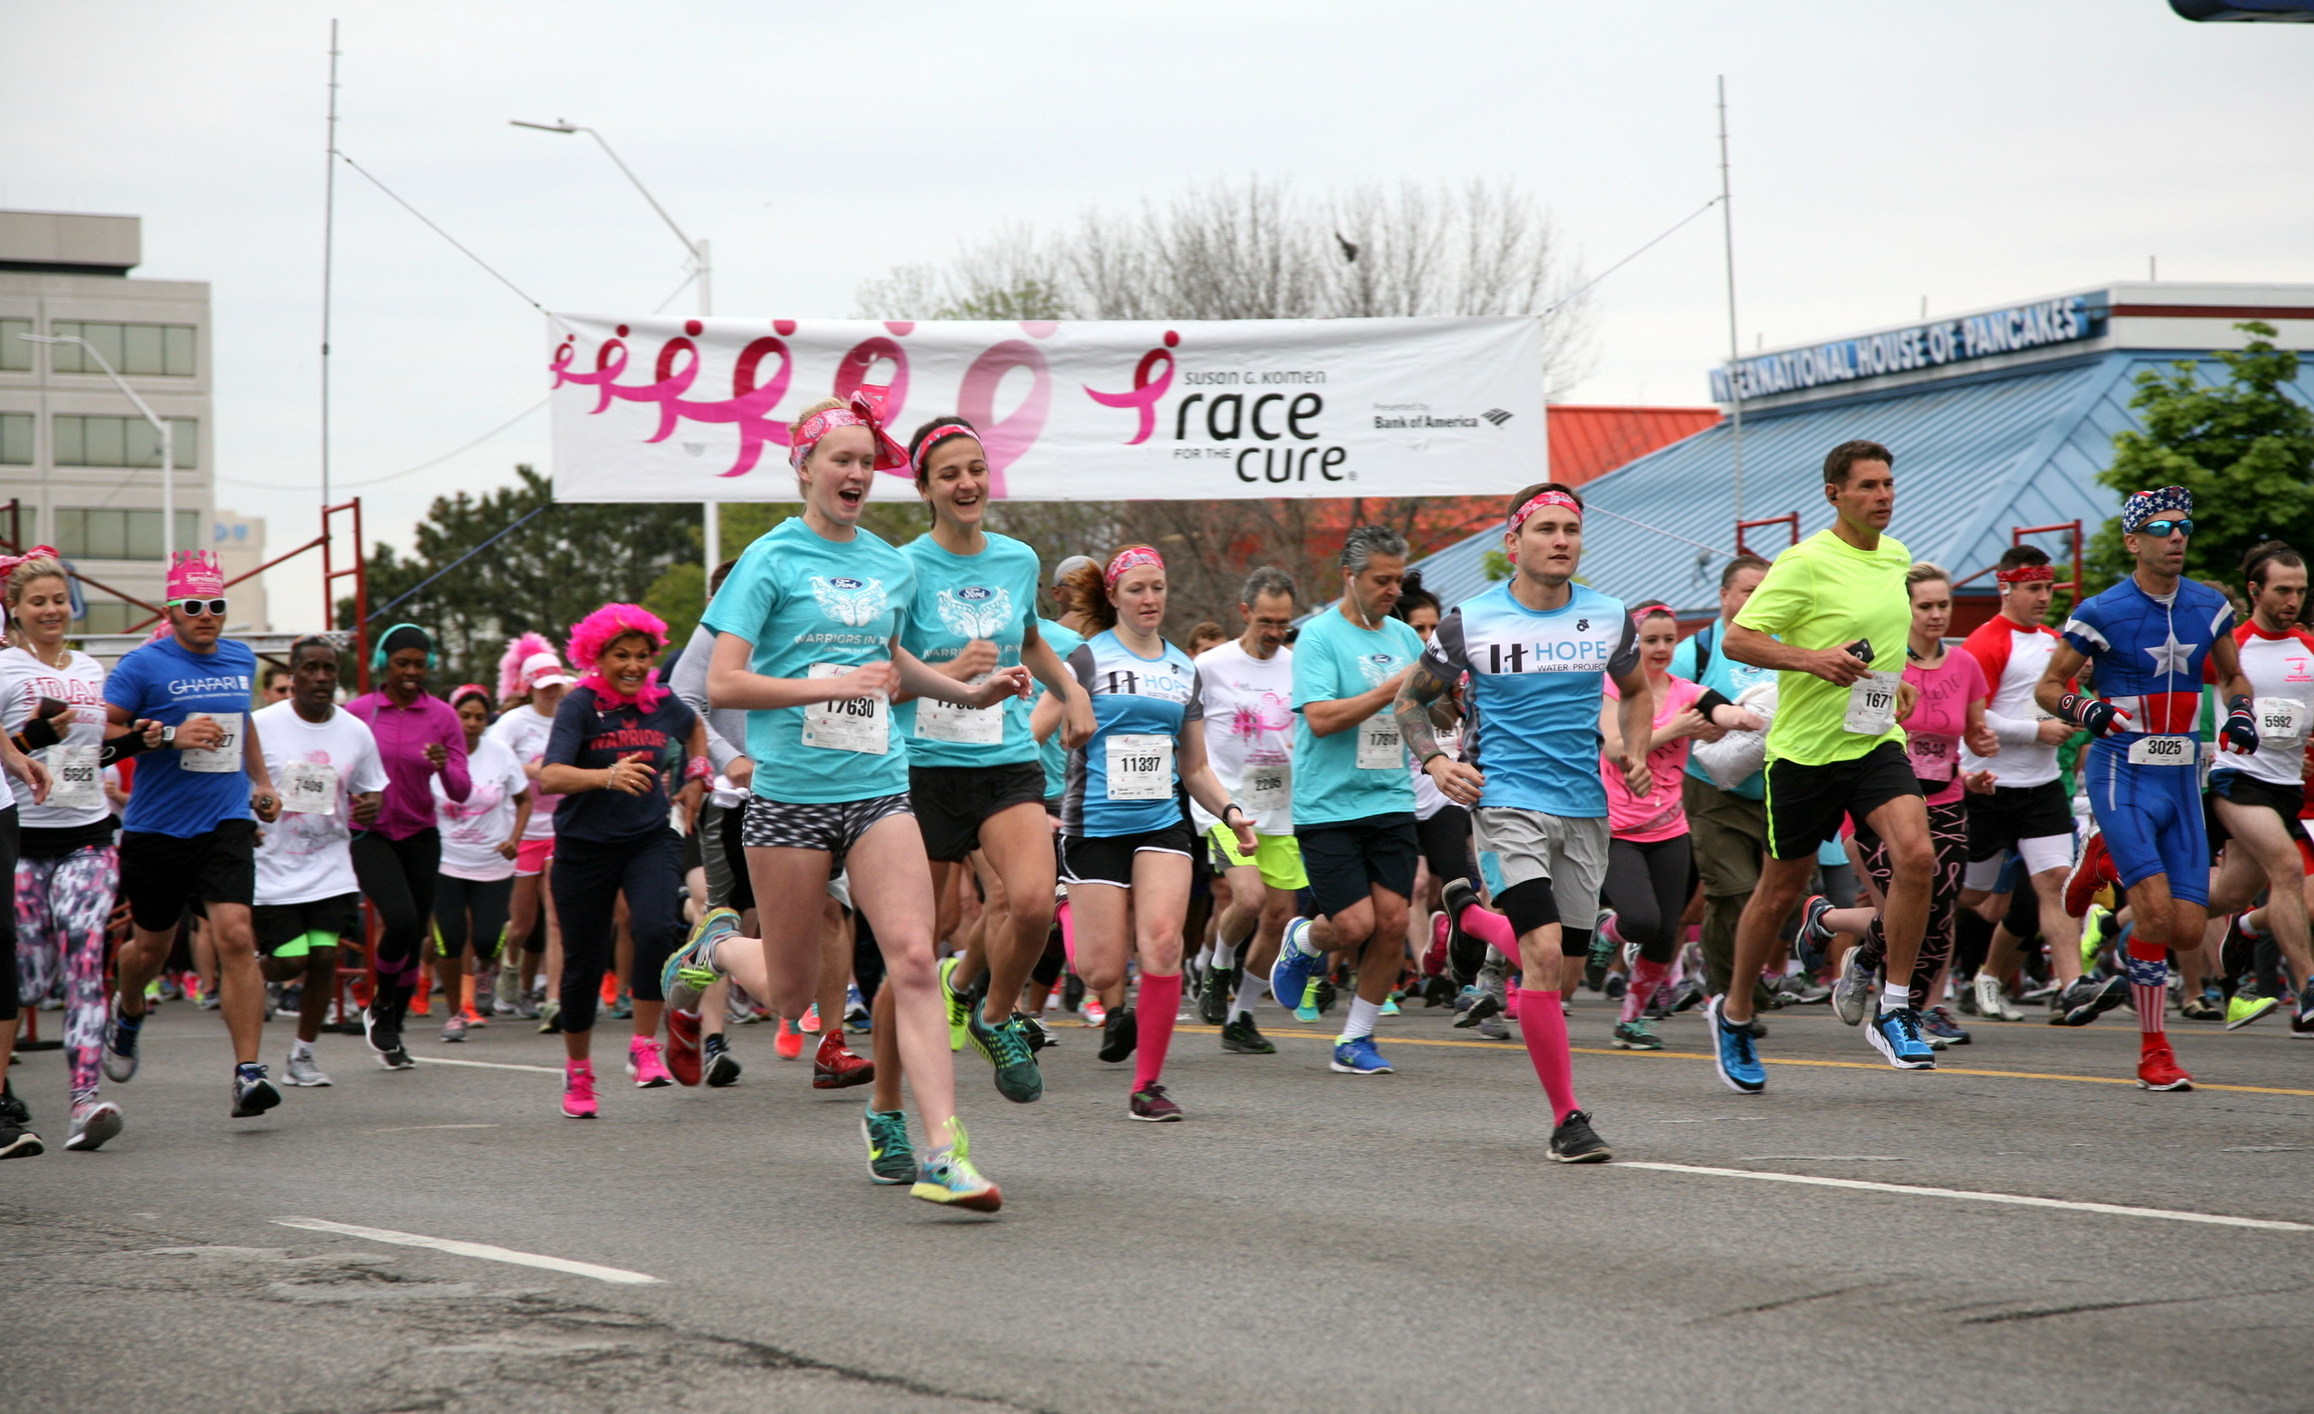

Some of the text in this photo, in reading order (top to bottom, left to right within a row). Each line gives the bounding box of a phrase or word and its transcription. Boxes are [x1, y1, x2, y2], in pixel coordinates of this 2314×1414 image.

[1856, 328, 1927, 376] HOUSE
[1928, 322, 1957, 364] OF
[1960, 300, 2079, 357] PANCAKES
[1175, 392, 1323, 441] race
[1374, 415, 1479, 429] Bank of America
[1173, 449, 1231, 459] FOR THE
[1535, 641, 1608, 661] HOPE
[1537, 662, 1606, 672] WATER PROJECT
[167, 676, 240, 695] GHAFARI
[827, 697, 875, 719] 17630
[2148, 740, 2182, 755] 3025
[1121, 757, 1161, 772] 11337
